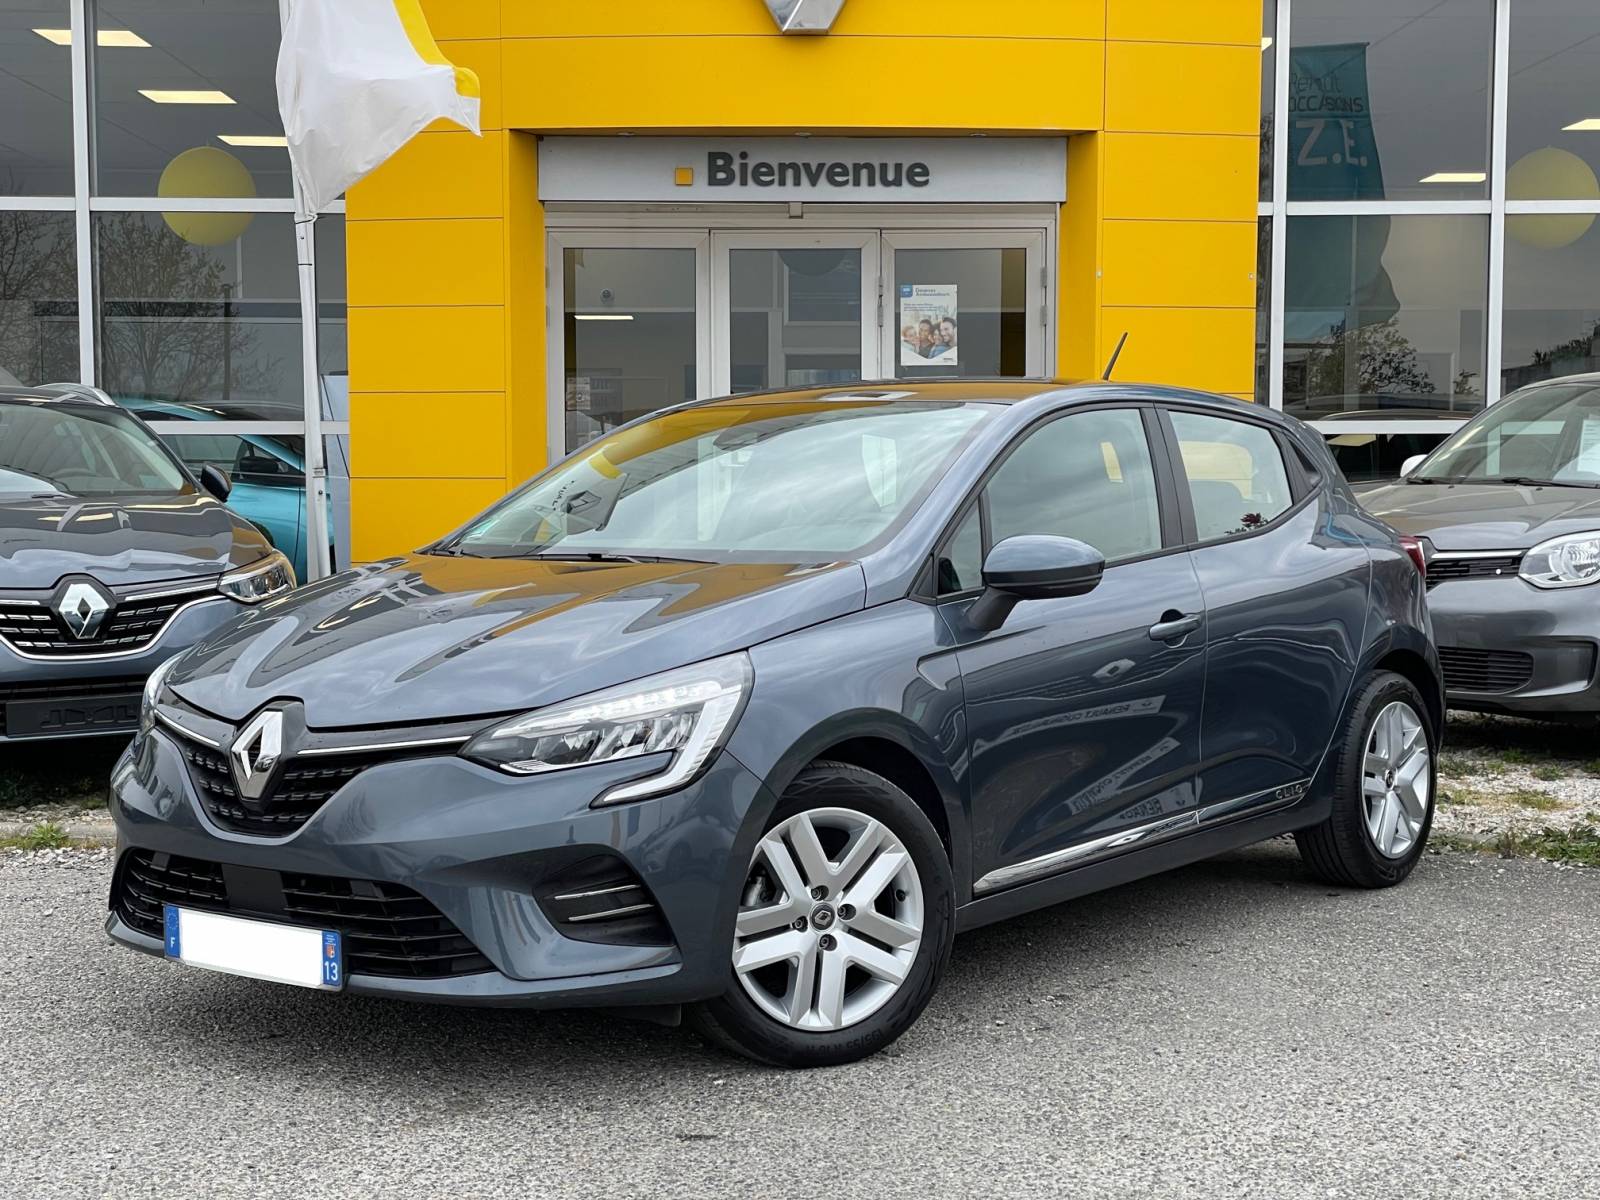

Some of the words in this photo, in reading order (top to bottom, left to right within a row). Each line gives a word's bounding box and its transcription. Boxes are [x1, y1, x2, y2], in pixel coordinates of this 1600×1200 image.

[707, 151, 930, 187] Bienvenue
[1275, 784, 1303, 799] CLIO
[170, 936, 176, 948] F
[324, 960, 338, 981] 13
